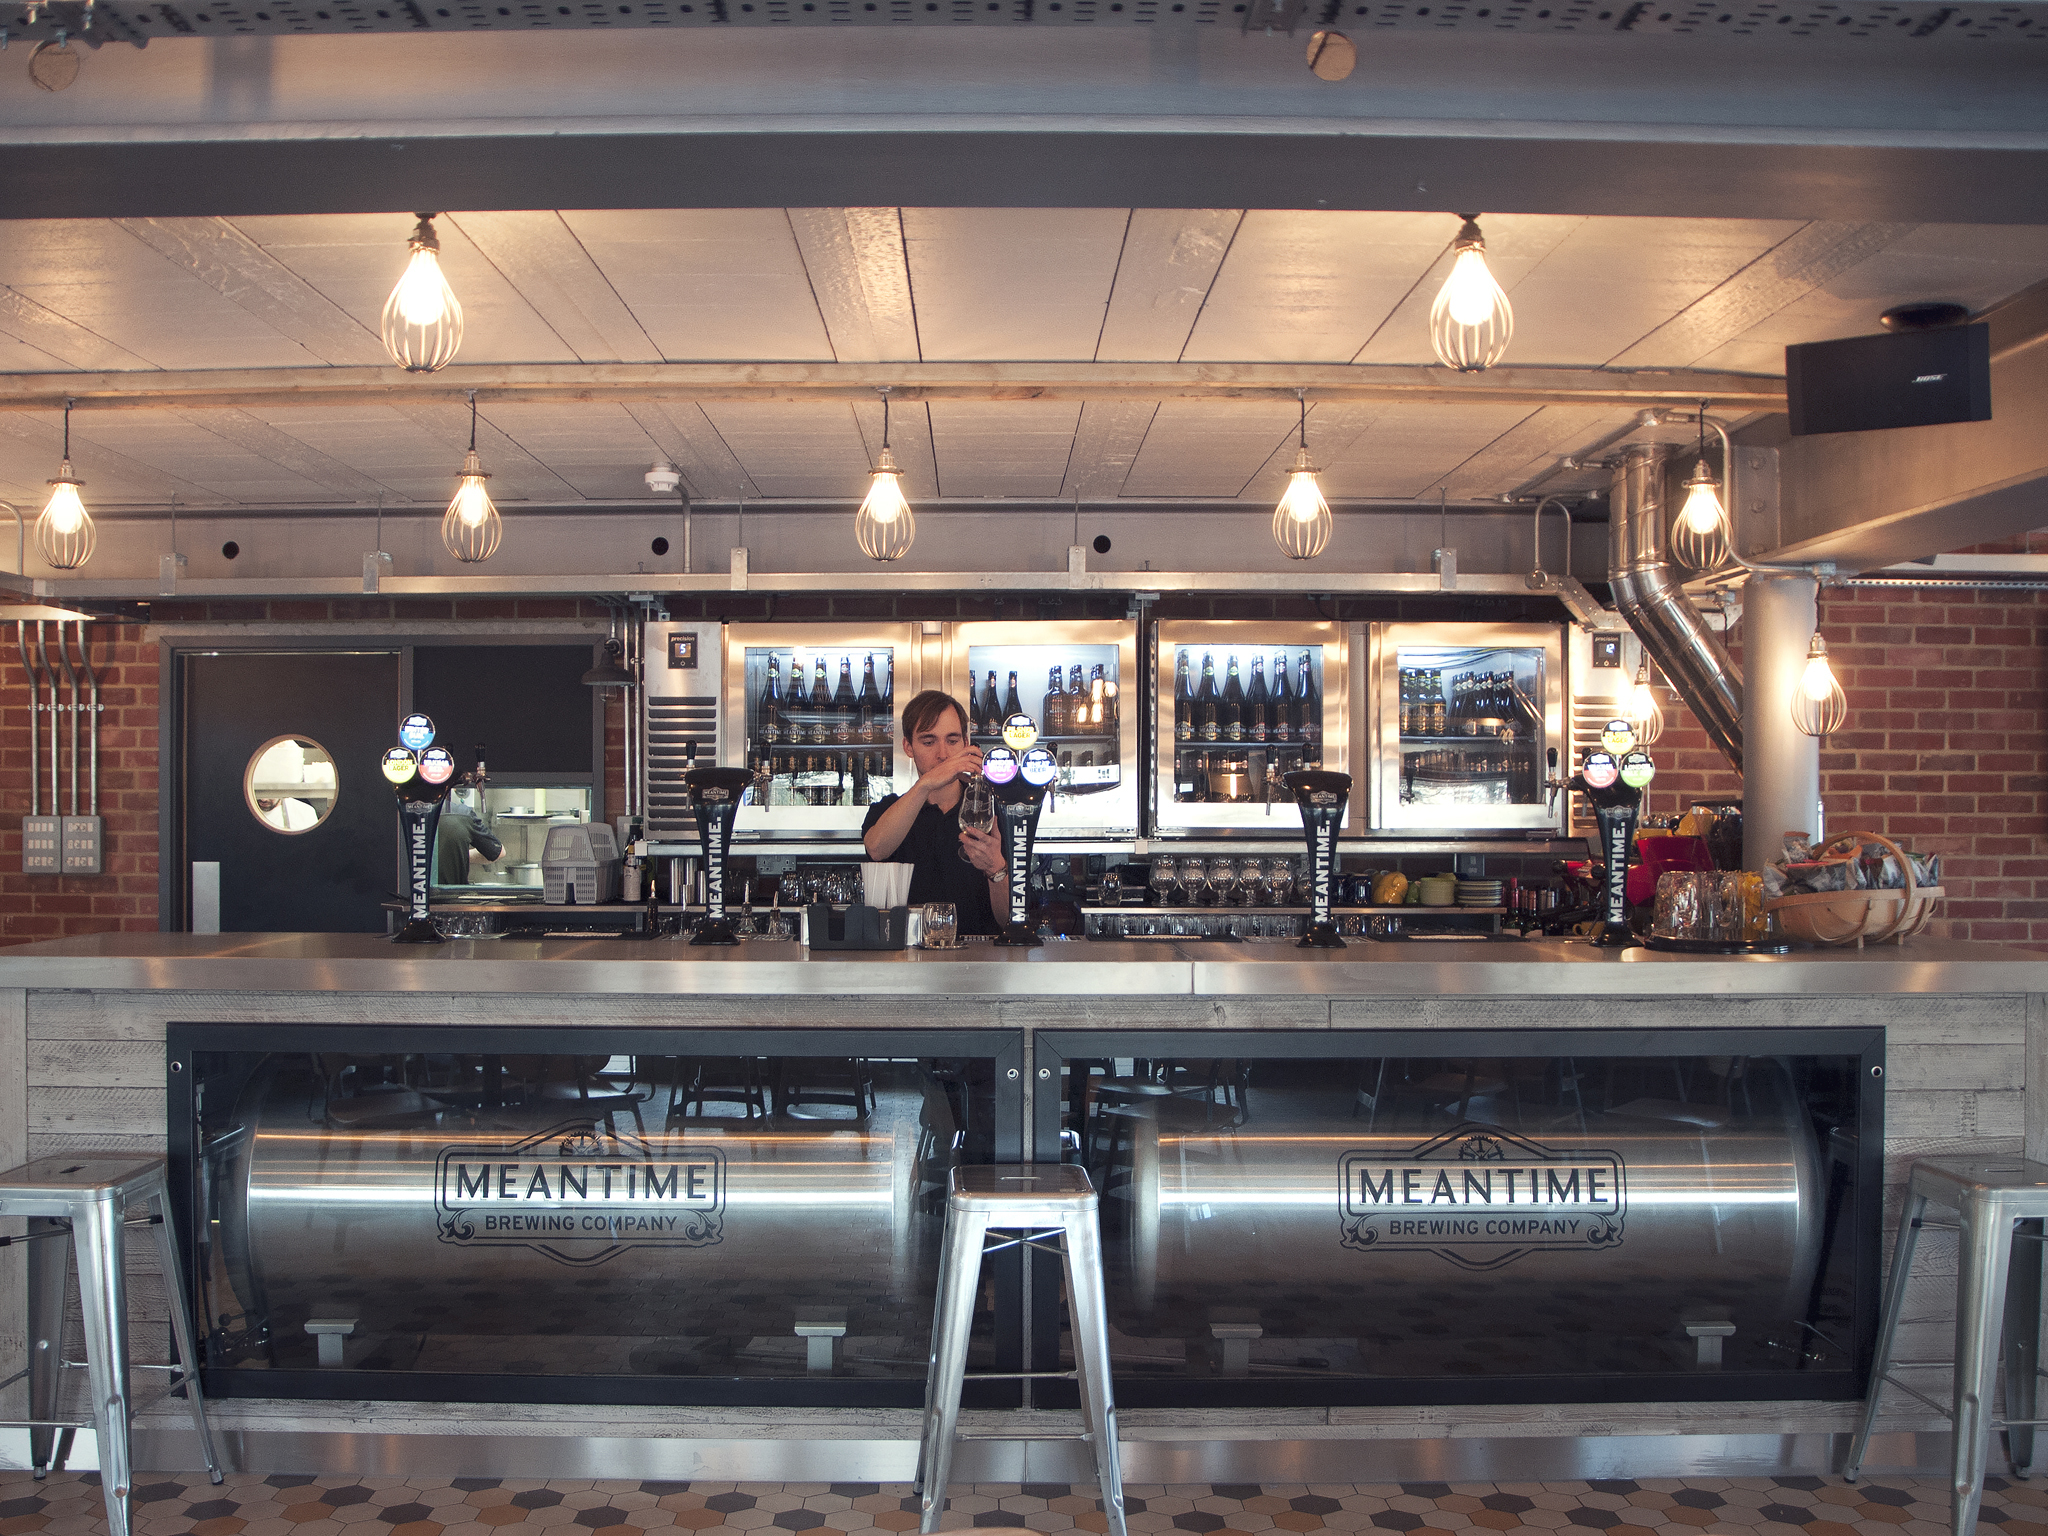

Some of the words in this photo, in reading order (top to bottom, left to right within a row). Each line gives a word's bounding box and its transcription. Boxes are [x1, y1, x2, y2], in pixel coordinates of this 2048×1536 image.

[454, 1163, 707, 1201] MEANTIME
[1359, 1168, 1608, 1206] MEANTIME
[485, 1216, 575, 1231] BREWING
[581, 1215, 678, 1231] COMPANY
[1389, 1220, 1479, 1235] BREWING
[1486, 1219, 1581, 1235] COMPANY
